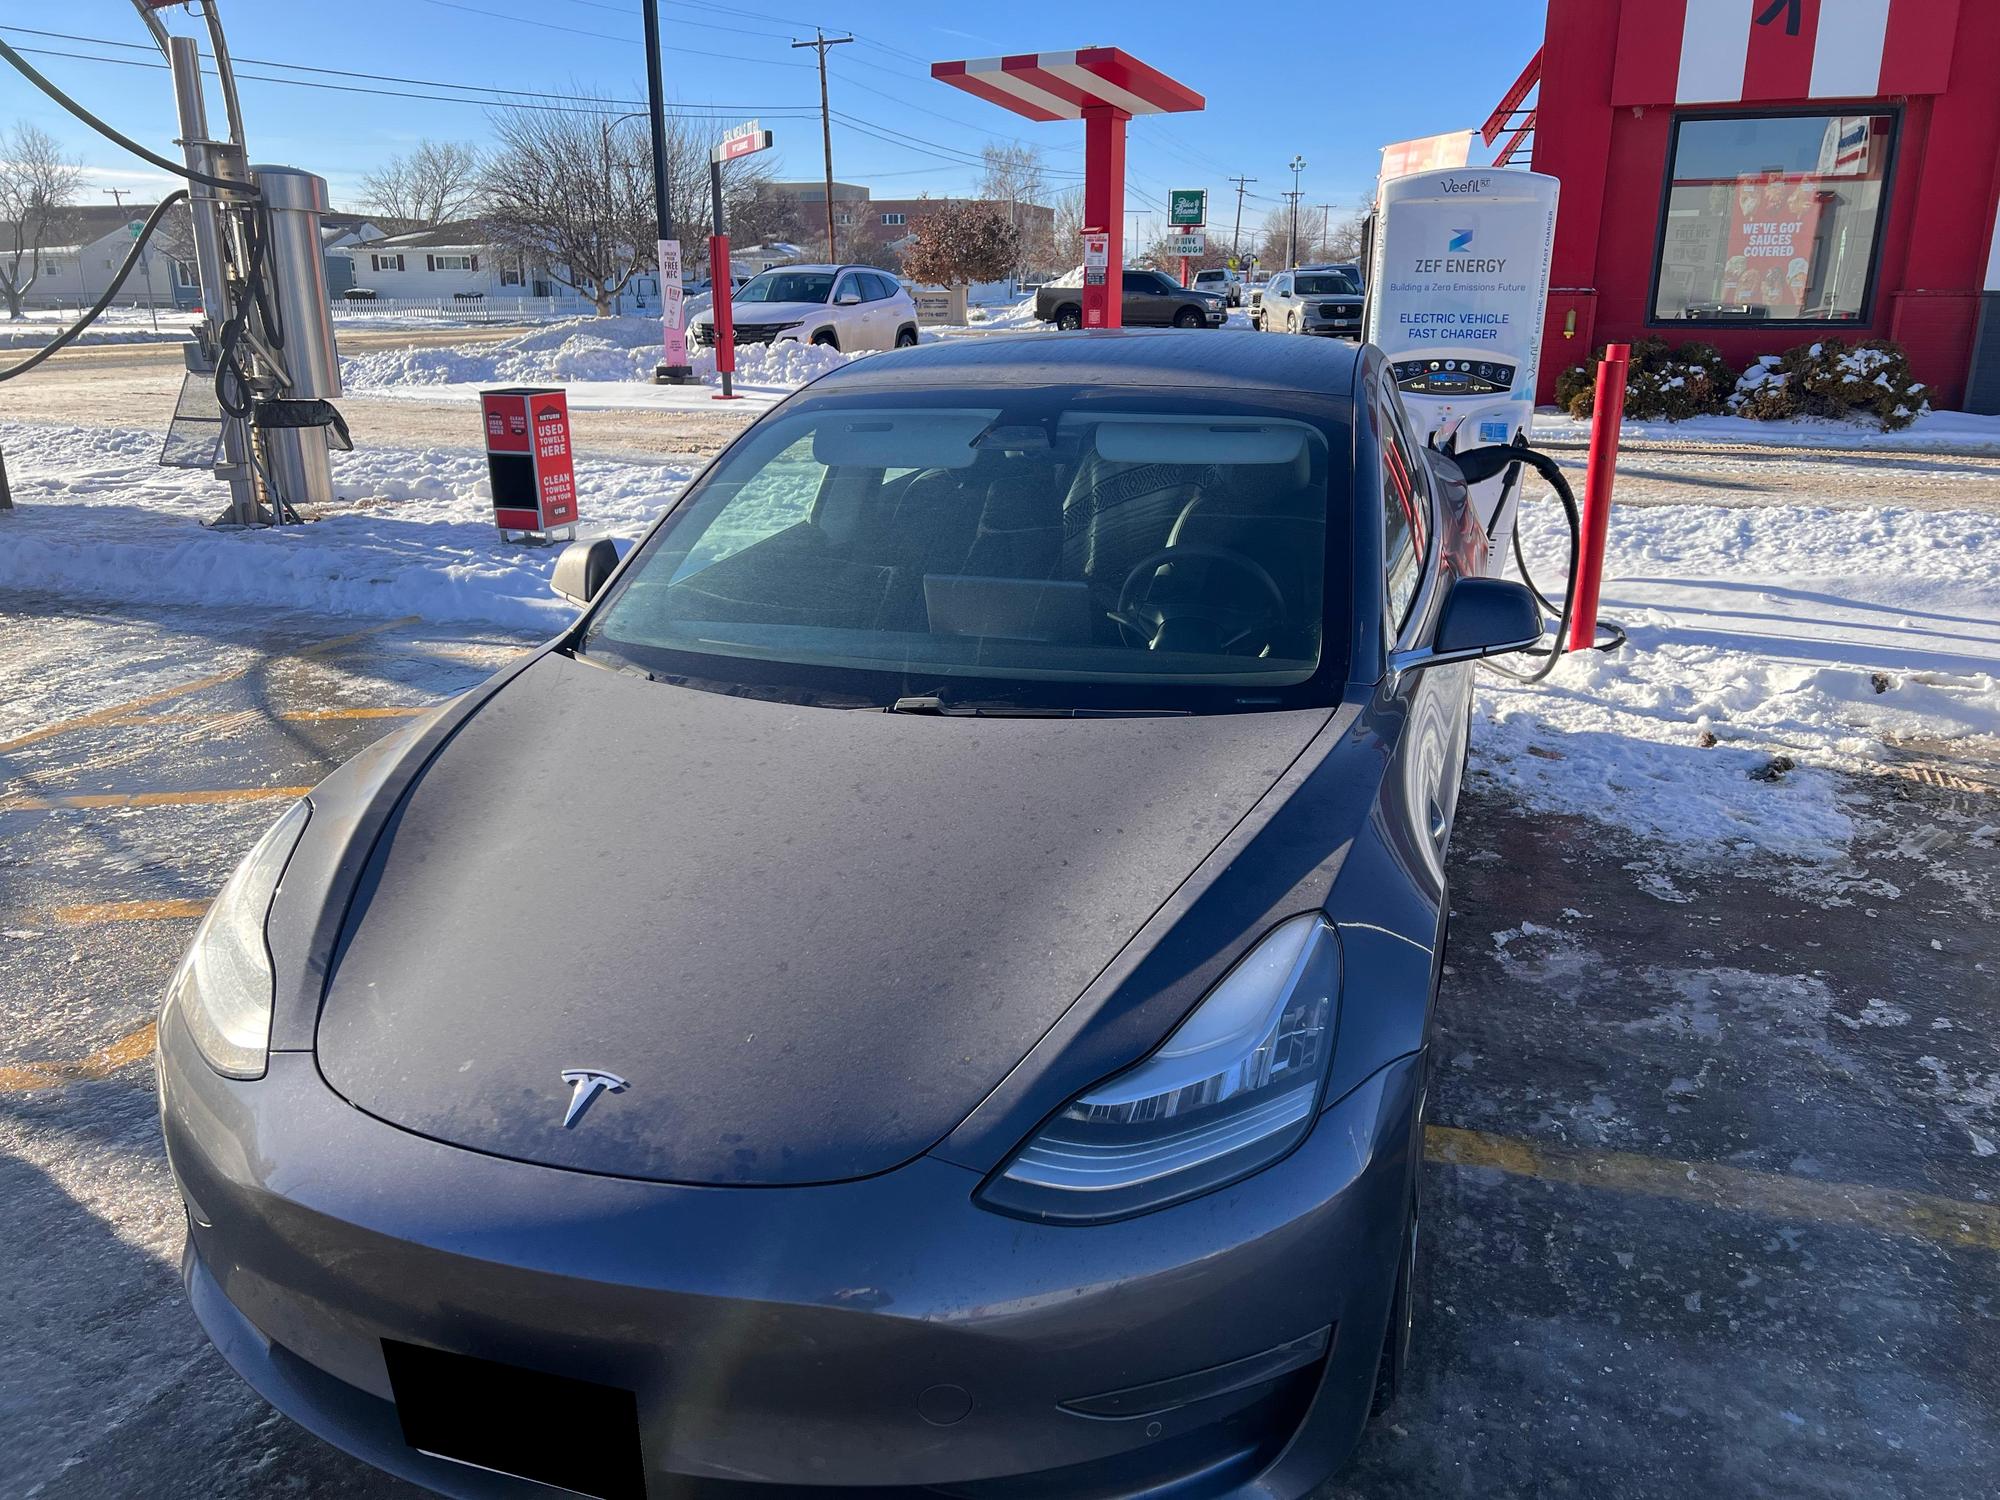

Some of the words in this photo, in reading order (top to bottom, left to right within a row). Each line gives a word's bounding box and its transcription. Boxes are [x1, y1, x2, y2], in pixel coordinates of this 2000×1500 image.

[1441, 179, 1480, 193] Veefil
[1743, 222, 1777, 234] WE'VE
[1780, 222, 1803, 234] GOT
[1749, 234, 1792, 246] SAUCES
[1539, 267, 1547, 298] VEHICLE
[1545, 210, 1553, 247] CHARGER
[1743, 245, 1794, 257] COVERED
[664, 261, 678, 271] FREE
[1415, 259, 1442, 273] ZEF
[1446, 259, 1507, 273] ENERGY
[666, 270, 678, 279] KFC
[1390, 283, 1422, 293] Building
[1432, 283, 1451, 291] Zero
[1453, 283, 1495, 292] Emissions
[1498, 283, 1526, 291] Future
[1400, 313, 1456, 324] ELECTRIC
[1459, 313, 1509, 324] VEHICLE
[1408, 328, 1437, 339] FAST
[1441, 328, 1498, 339] CHARGER
[538, 424, 563, 437] USED
[539, 435, 565, 446] TOWELS
[541, 444, 566, 457] HERE
[543, 473, 570, 486] CLEAN
[545, 483, 571, 495] TOWELS
[546, 495, 557, 503] FOR
[557, 492, 571, 501] YOUR
[554, 506, 566, 515] USE
